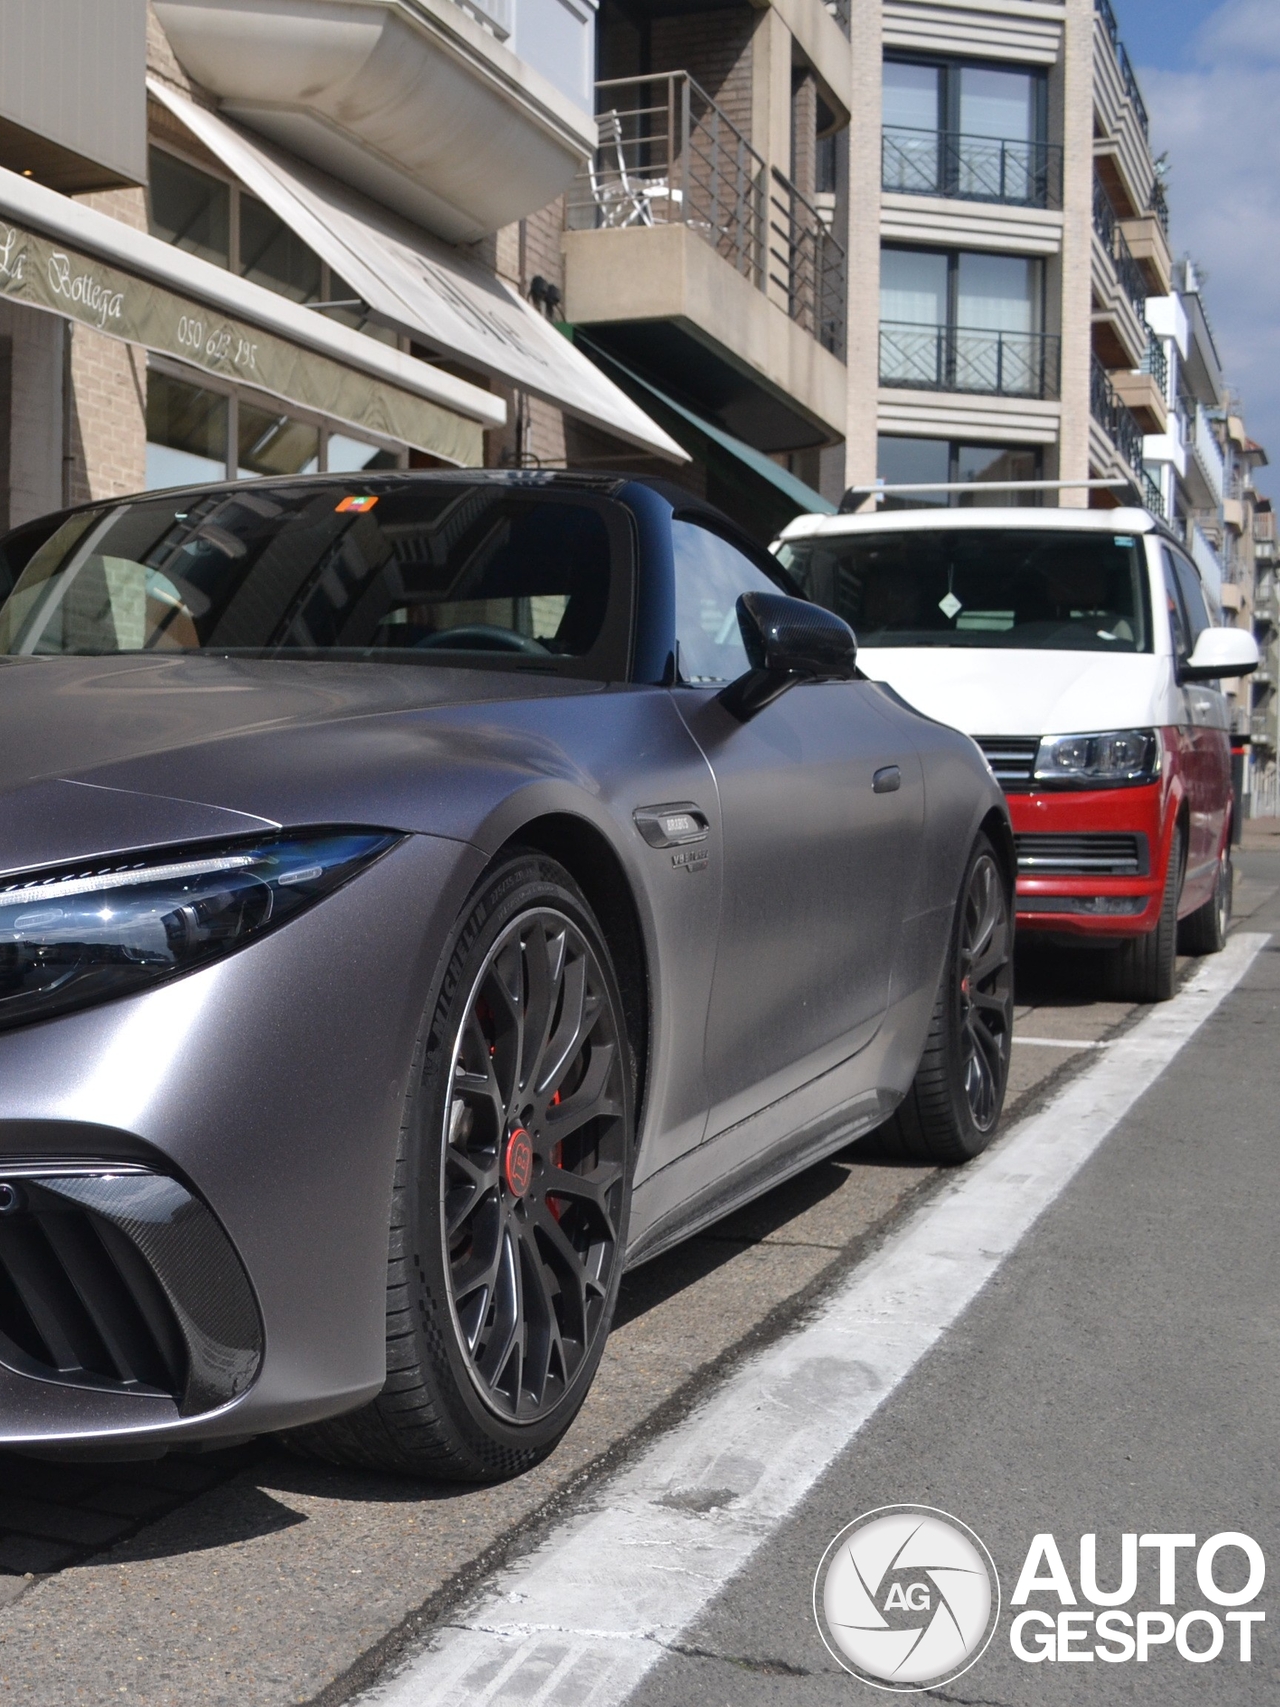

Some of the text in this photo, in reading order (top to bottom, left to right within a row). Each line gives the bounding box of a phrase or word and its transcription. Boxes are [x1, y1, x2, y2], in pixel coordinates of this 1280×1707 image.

[48, 252, 124, 328] Bottega
[234, 339, 258, 369] 195
[431, 903, 488, 1040] MICHELIN
